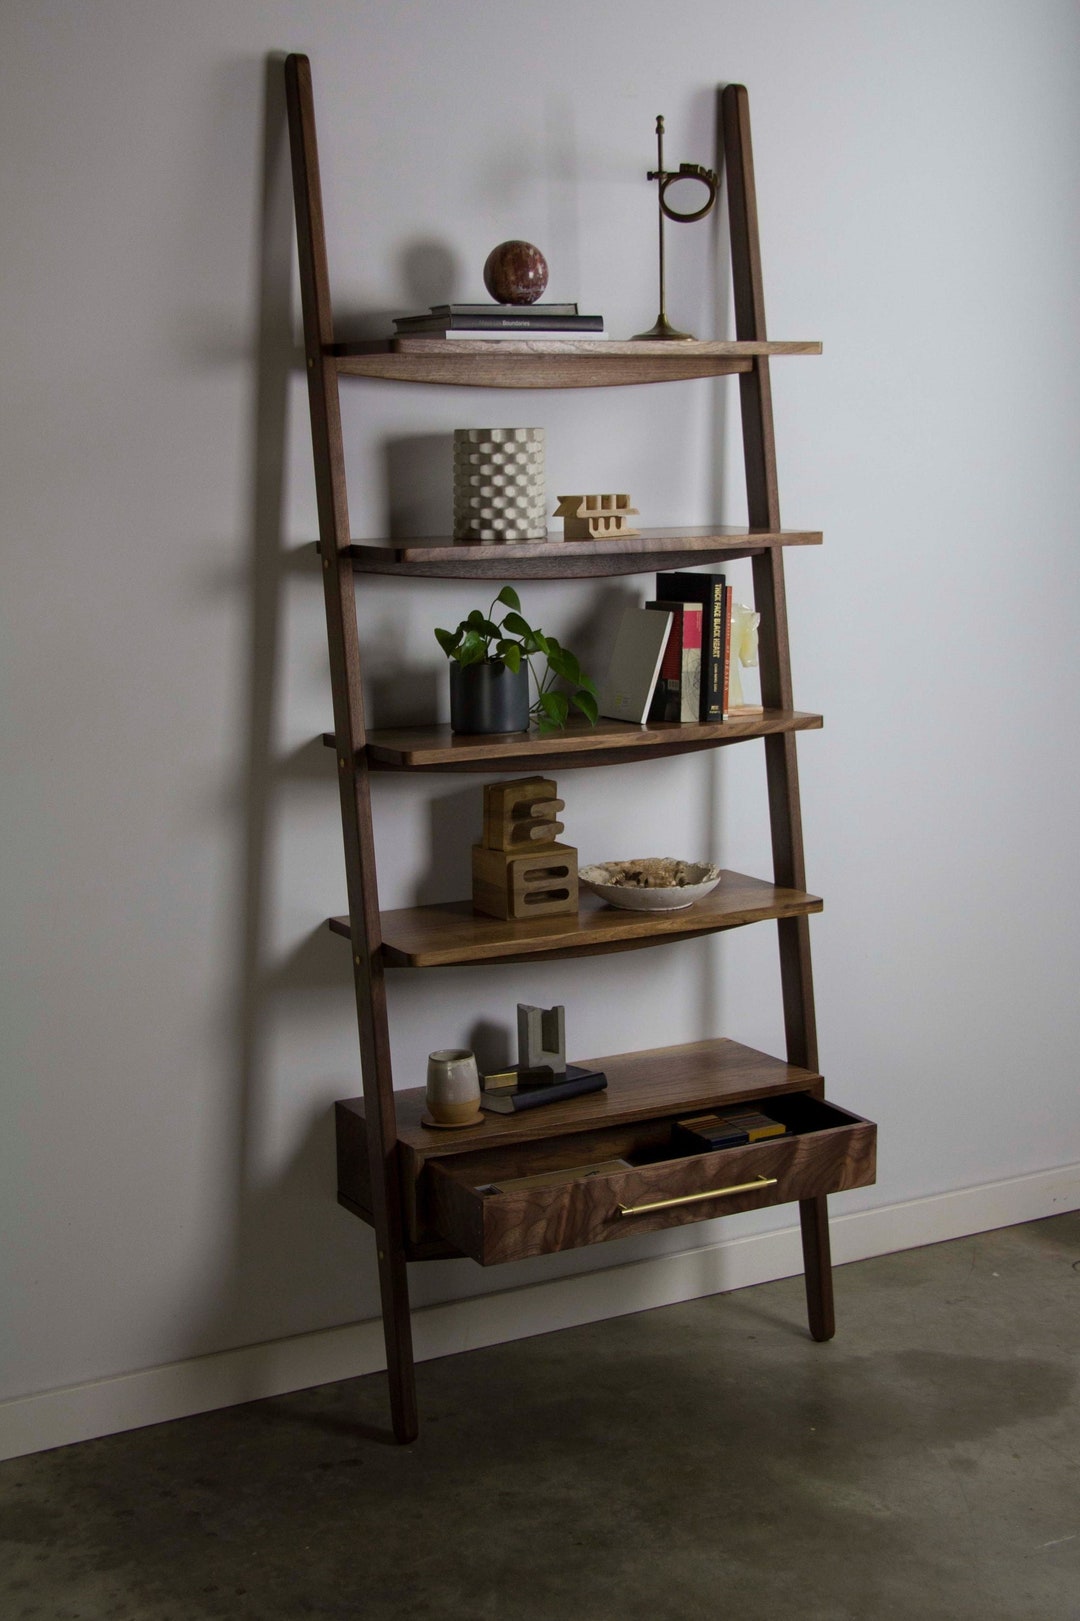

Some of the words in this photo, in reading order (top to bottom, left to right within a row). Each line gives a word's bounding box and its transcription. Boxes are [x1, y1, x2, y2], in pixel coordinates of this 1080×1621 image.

[714, 583, 722, 601] THICK
[713, 602, 722, 617] FACE
[713, 618, 721, 637] BLACK
[712, 638, 721, 658] HEART
